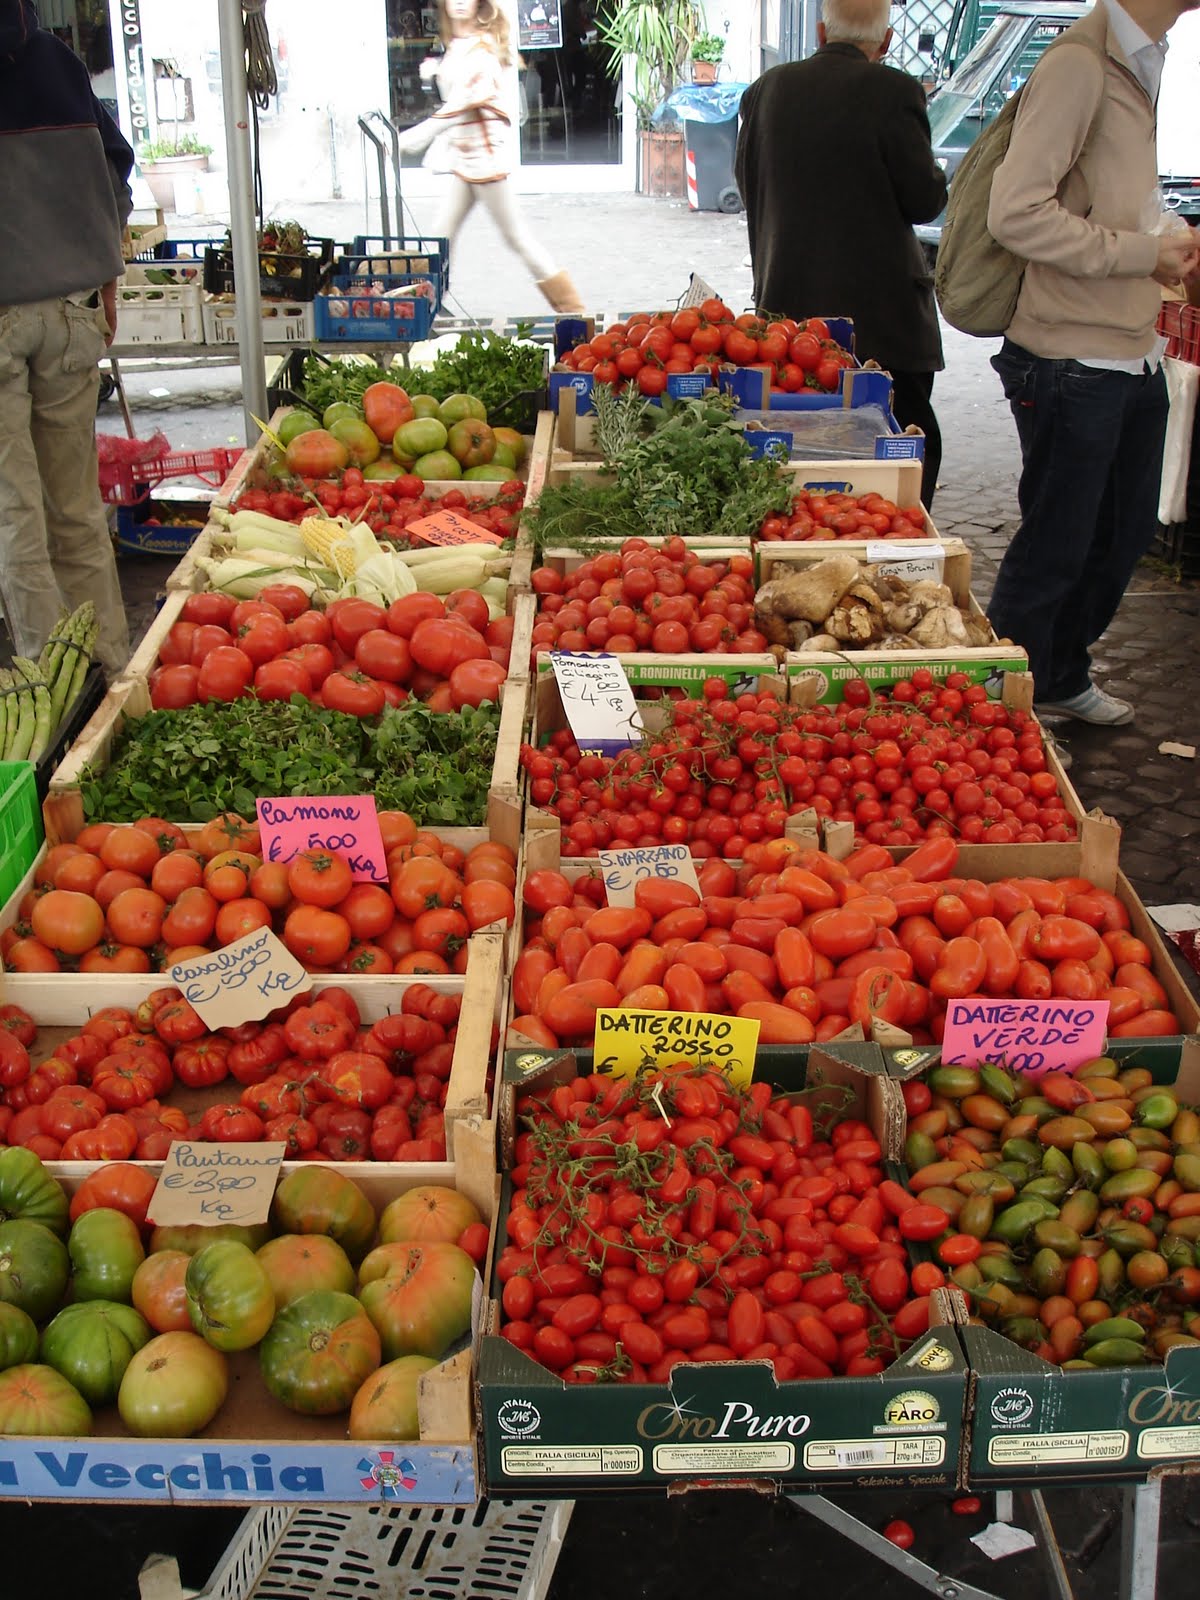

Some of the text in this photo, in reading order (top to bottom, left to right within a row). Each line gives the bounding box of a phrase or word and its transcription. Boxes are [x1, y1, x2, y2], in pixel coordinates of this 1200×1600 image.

[551, 655, 611, 668] Pomodoro
[640, 667, 706, 680] RONDINELLA
[864, 667, 889, 679] AGR.
[260, 800, 360, 825] Camone
[606, 871, 632, 890] €
[172, 933, 268, 982] Casalino
[186, 983, 220, 1003] €
[953, 1005, 1095, 1026] DATTERINO
[600, 1014, 731, 1038] DATTERINO
[973, 1027, 1085, 1048] VERDE
[652, 1036, 733, 1056] ROSSO
[920, 1346, 944, 1366] FARO
[998, 1387, 1027, 1397] ITALIA
[503, 1399, 532, 1409] ITALIA
[888, 1409, 936, 1421] FARO
[874, 1425, 917, 1433] Cooperativa
[1051, 1438, 1087, 1447] (SICILIA)
[564, 1451, 600, 1459] (SICILIA)
[35, 1451, 325, 1493] Vecchia
[856, 1473, 946, 1487] Selezione Speciale
